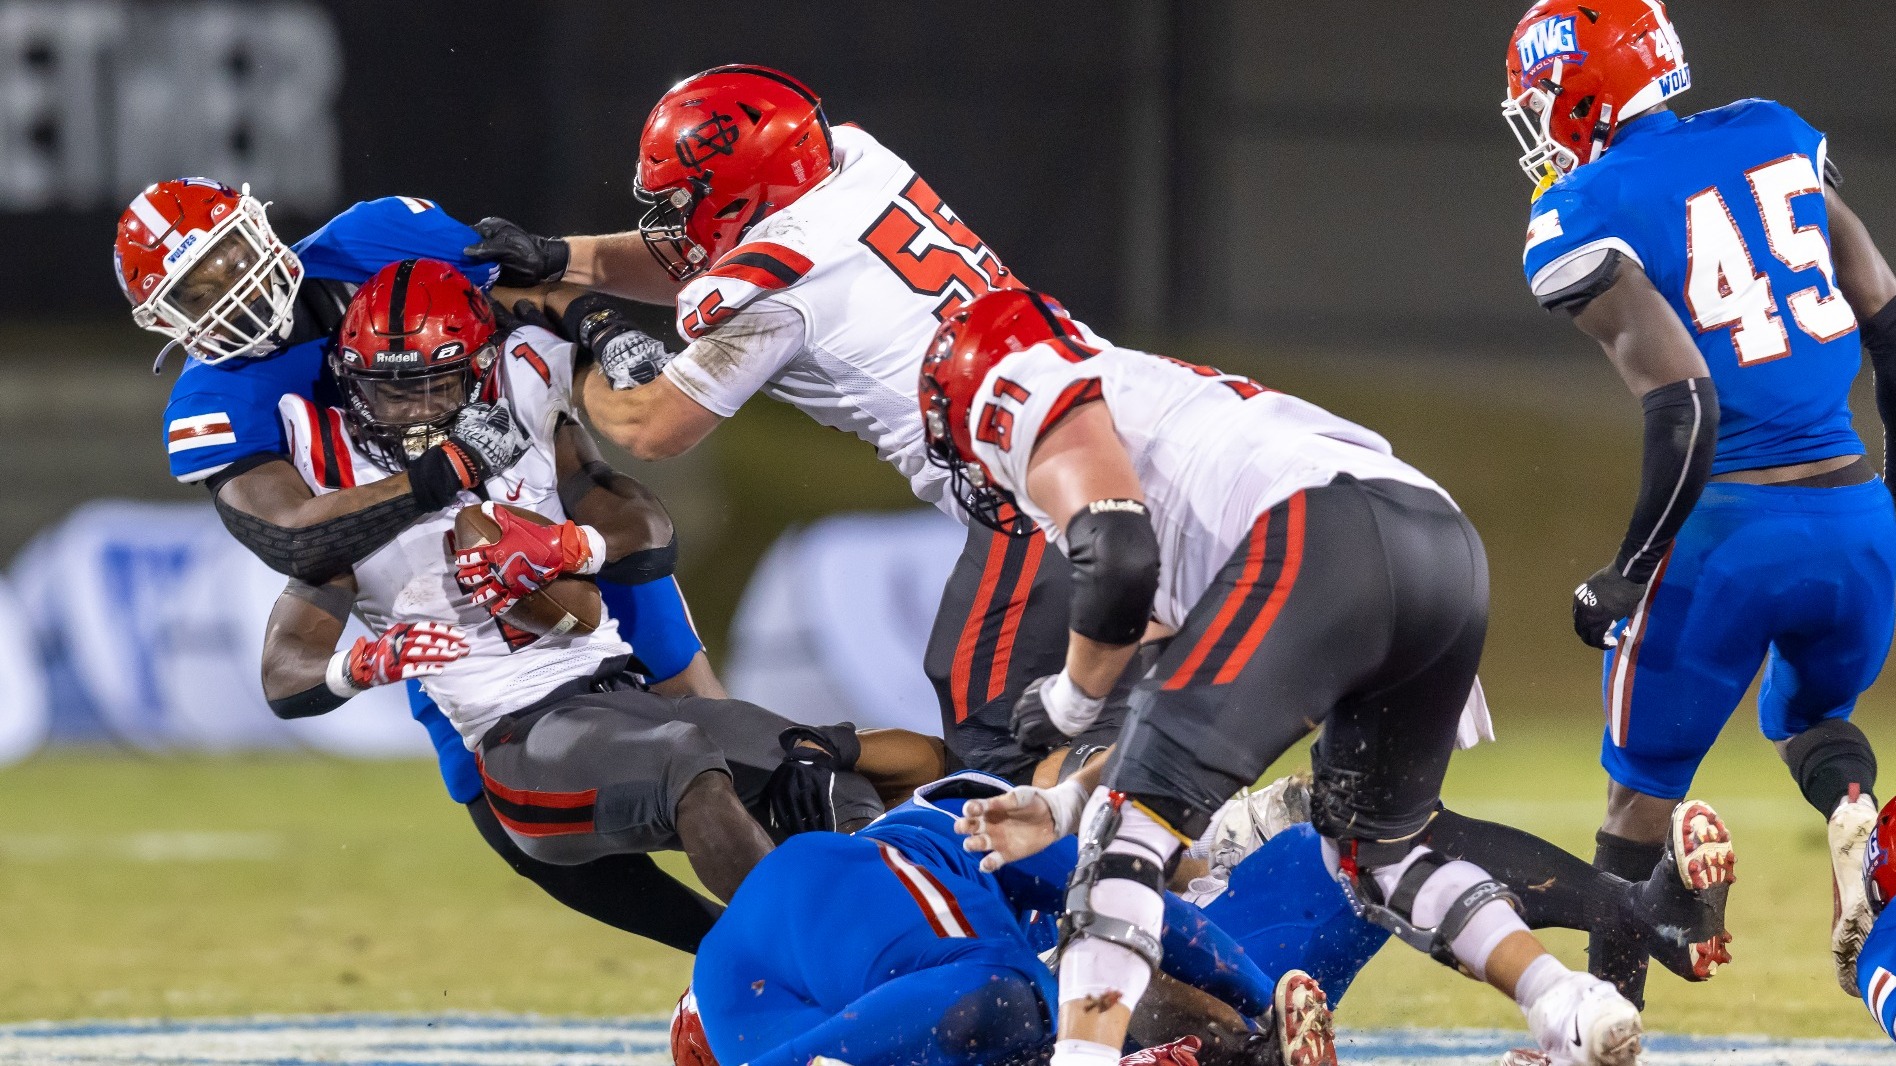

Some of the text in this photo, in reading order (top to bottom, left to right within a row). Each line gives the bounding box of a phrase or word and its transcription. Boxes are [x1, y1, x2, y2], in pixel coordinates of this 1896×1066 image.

[1516, 18, 1576, 72] UWG
[167, 234, 198, 264] WOLVES
[1683, 153, 1858, 367] 45
[375, 351, 419, 364] Riddell
[510, 341, 552, 390] 1
